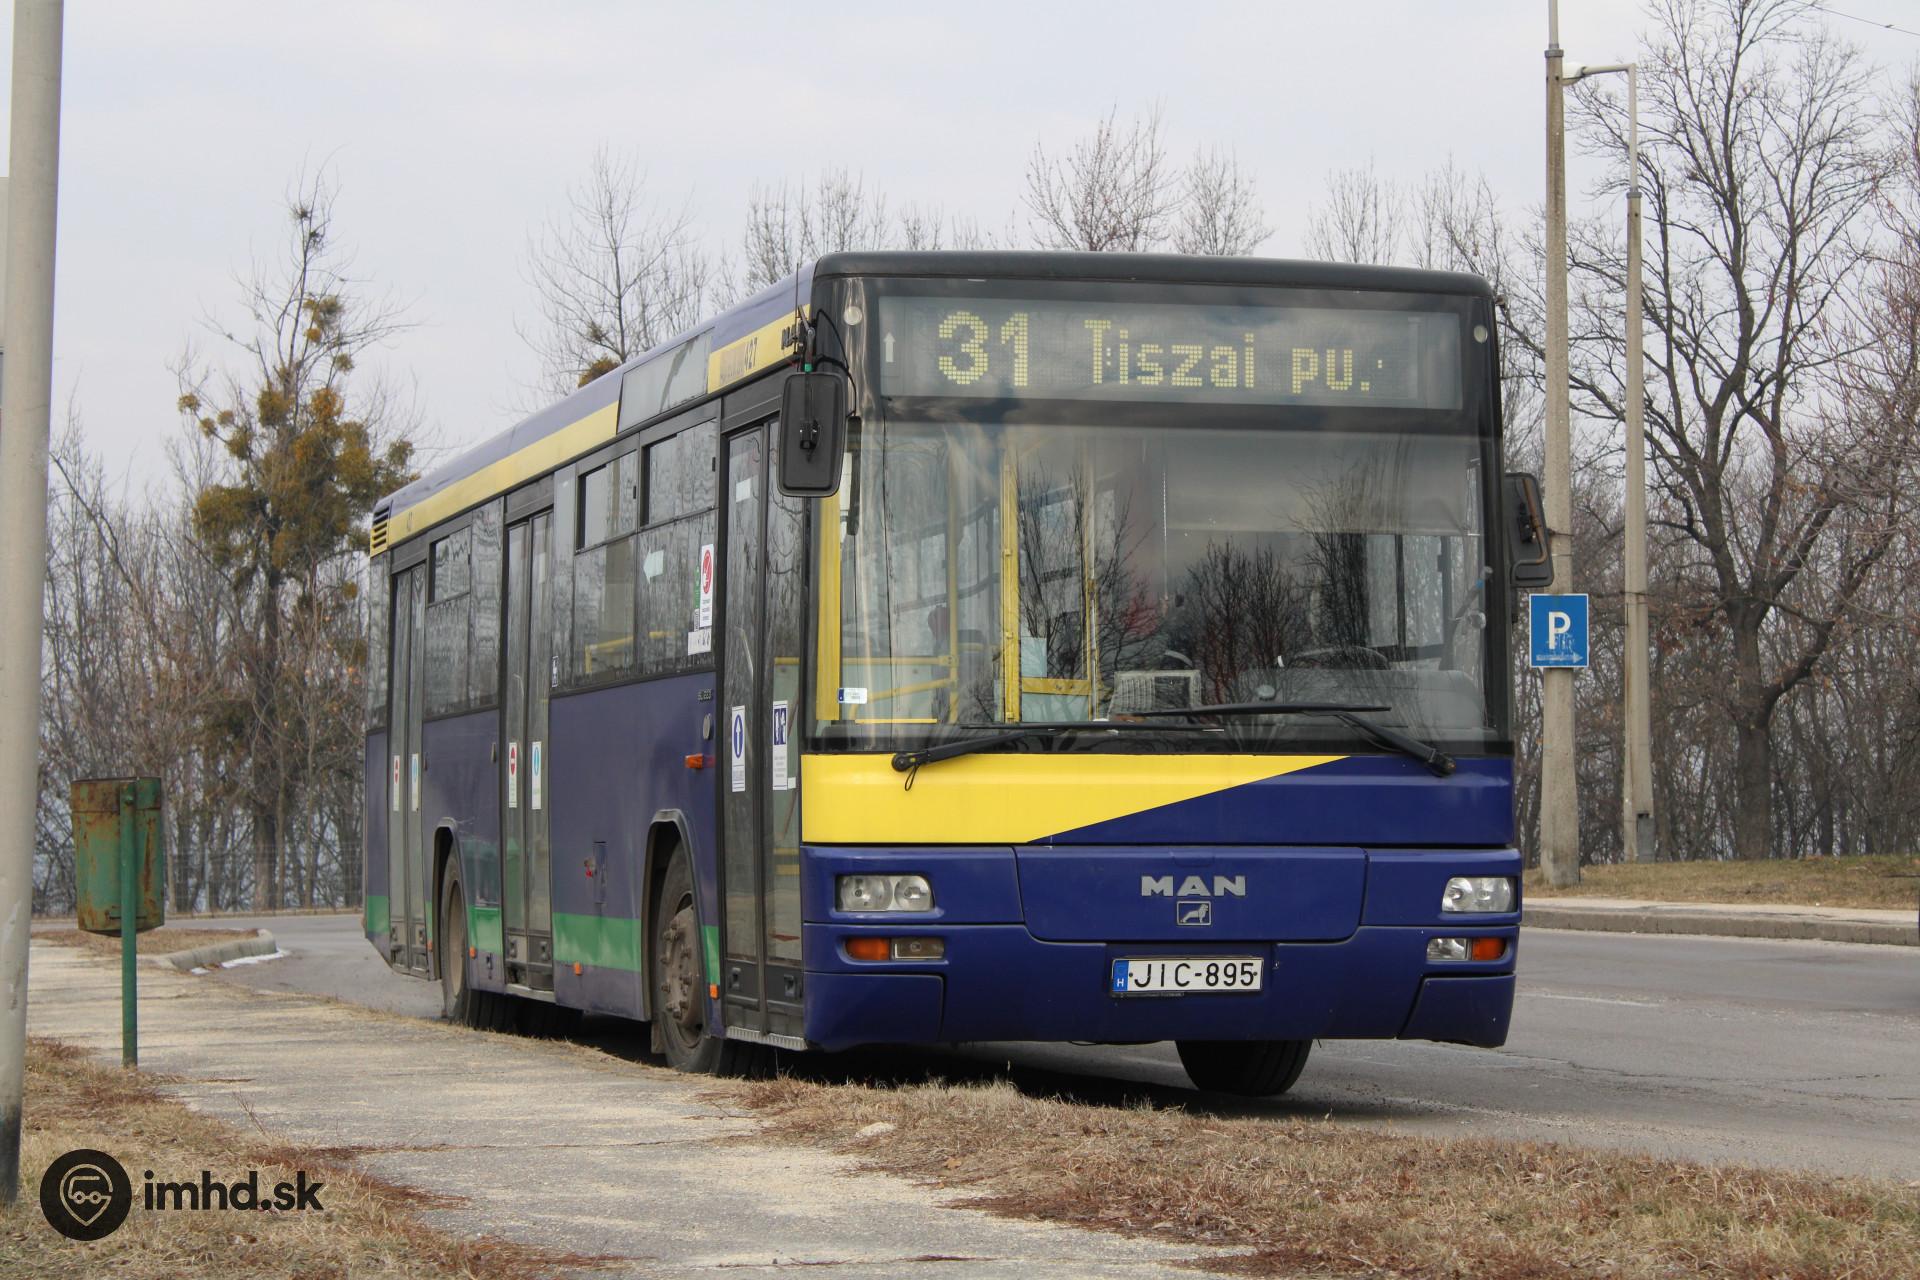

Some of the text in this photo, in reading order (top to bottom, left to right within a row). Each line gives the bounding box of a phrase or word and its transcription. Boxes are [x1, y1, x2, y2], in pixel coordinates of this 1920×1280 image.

[938, 311, 1029, 387] 31
[1084, 319, 1255, 389] Tiszai
[1548, 611, 1571, 650] P
[1141, 875, 1246, 897] MAN
[1116, 962, 1256, 989] H JIC-895
